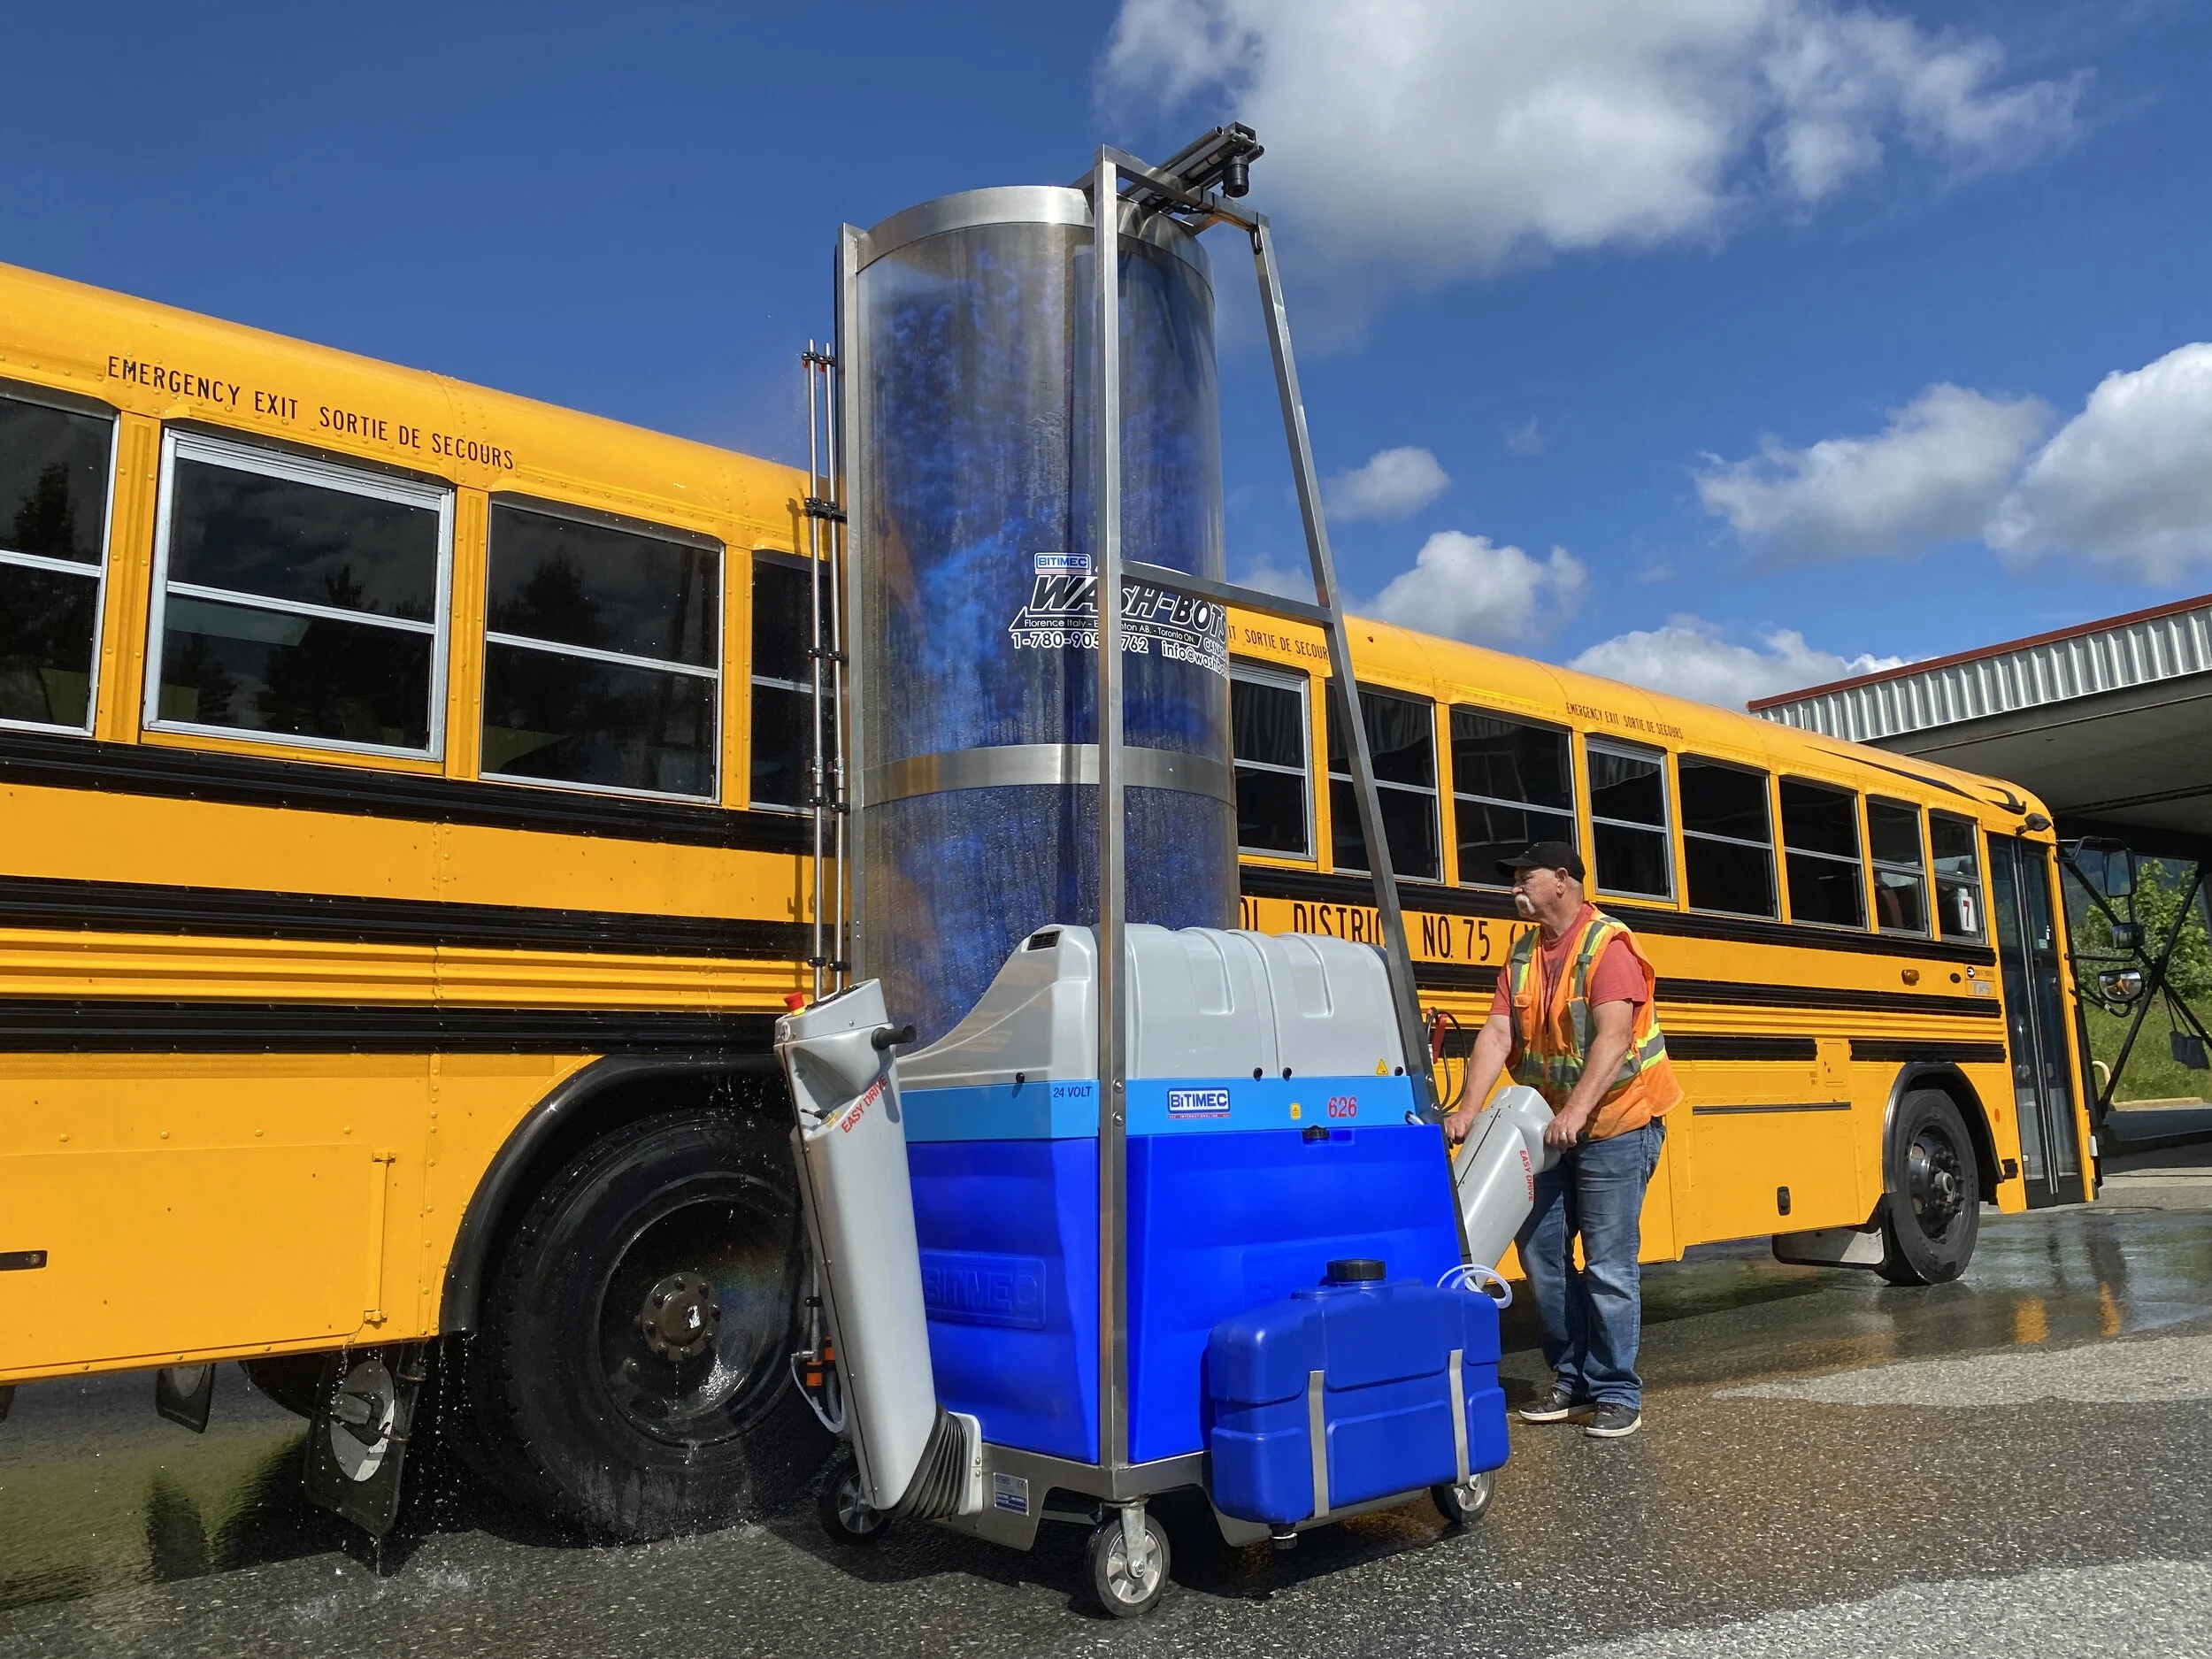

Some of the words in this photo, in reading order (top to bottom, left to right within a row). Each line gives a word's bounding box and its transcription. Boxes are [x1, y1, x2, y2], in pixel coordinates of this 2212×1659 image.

[108, 356, 240, 406] EMERGENCY
[255, 391, 298, 420] EXIT
[319, 406, 388, 442] SORTIE
[399, 426, 420, 449] DE
[432, 433, 514, 470] SECOURS
[1038, 557, 1087, 566] BITIMEC
[1024, 618, 1064, 627] Florence
[1067, 618, 1087, 628] Italy
[1157, 626, 1183, 641] Toronto
[1245, 628, 1277, 649] SORTIE
[1280, 636, 1292, 652] DE
[1295, 640, 1328, 660] SECOUR
[1565, 702, 1602, 721] EMERGENCY
[1604, 710, 1619, 726] EXIT
[1623, 715, 1646, 732] SORTIE
[1647, 721, 1655, 733] DE
[1656, 723, 1684, 740] SECOURS
[1962, 900, 1970, 927] 7
[1294, 902, 1386, 948] DISTRI
[1422, 914, 1454, 959] NO.
[1463, 918, 1490, 962] 75
[841, 1102, 864, 1133] EASY
[863, 1074, 887, 1107] DRIVE
[1053, 1087, 1064, 1098] 24
[1067, 1086, 1092, 1098] VOLT
[1328, 1096, 1357, 1118] 626
[1520, 1150, 1531, 1173] EASY
